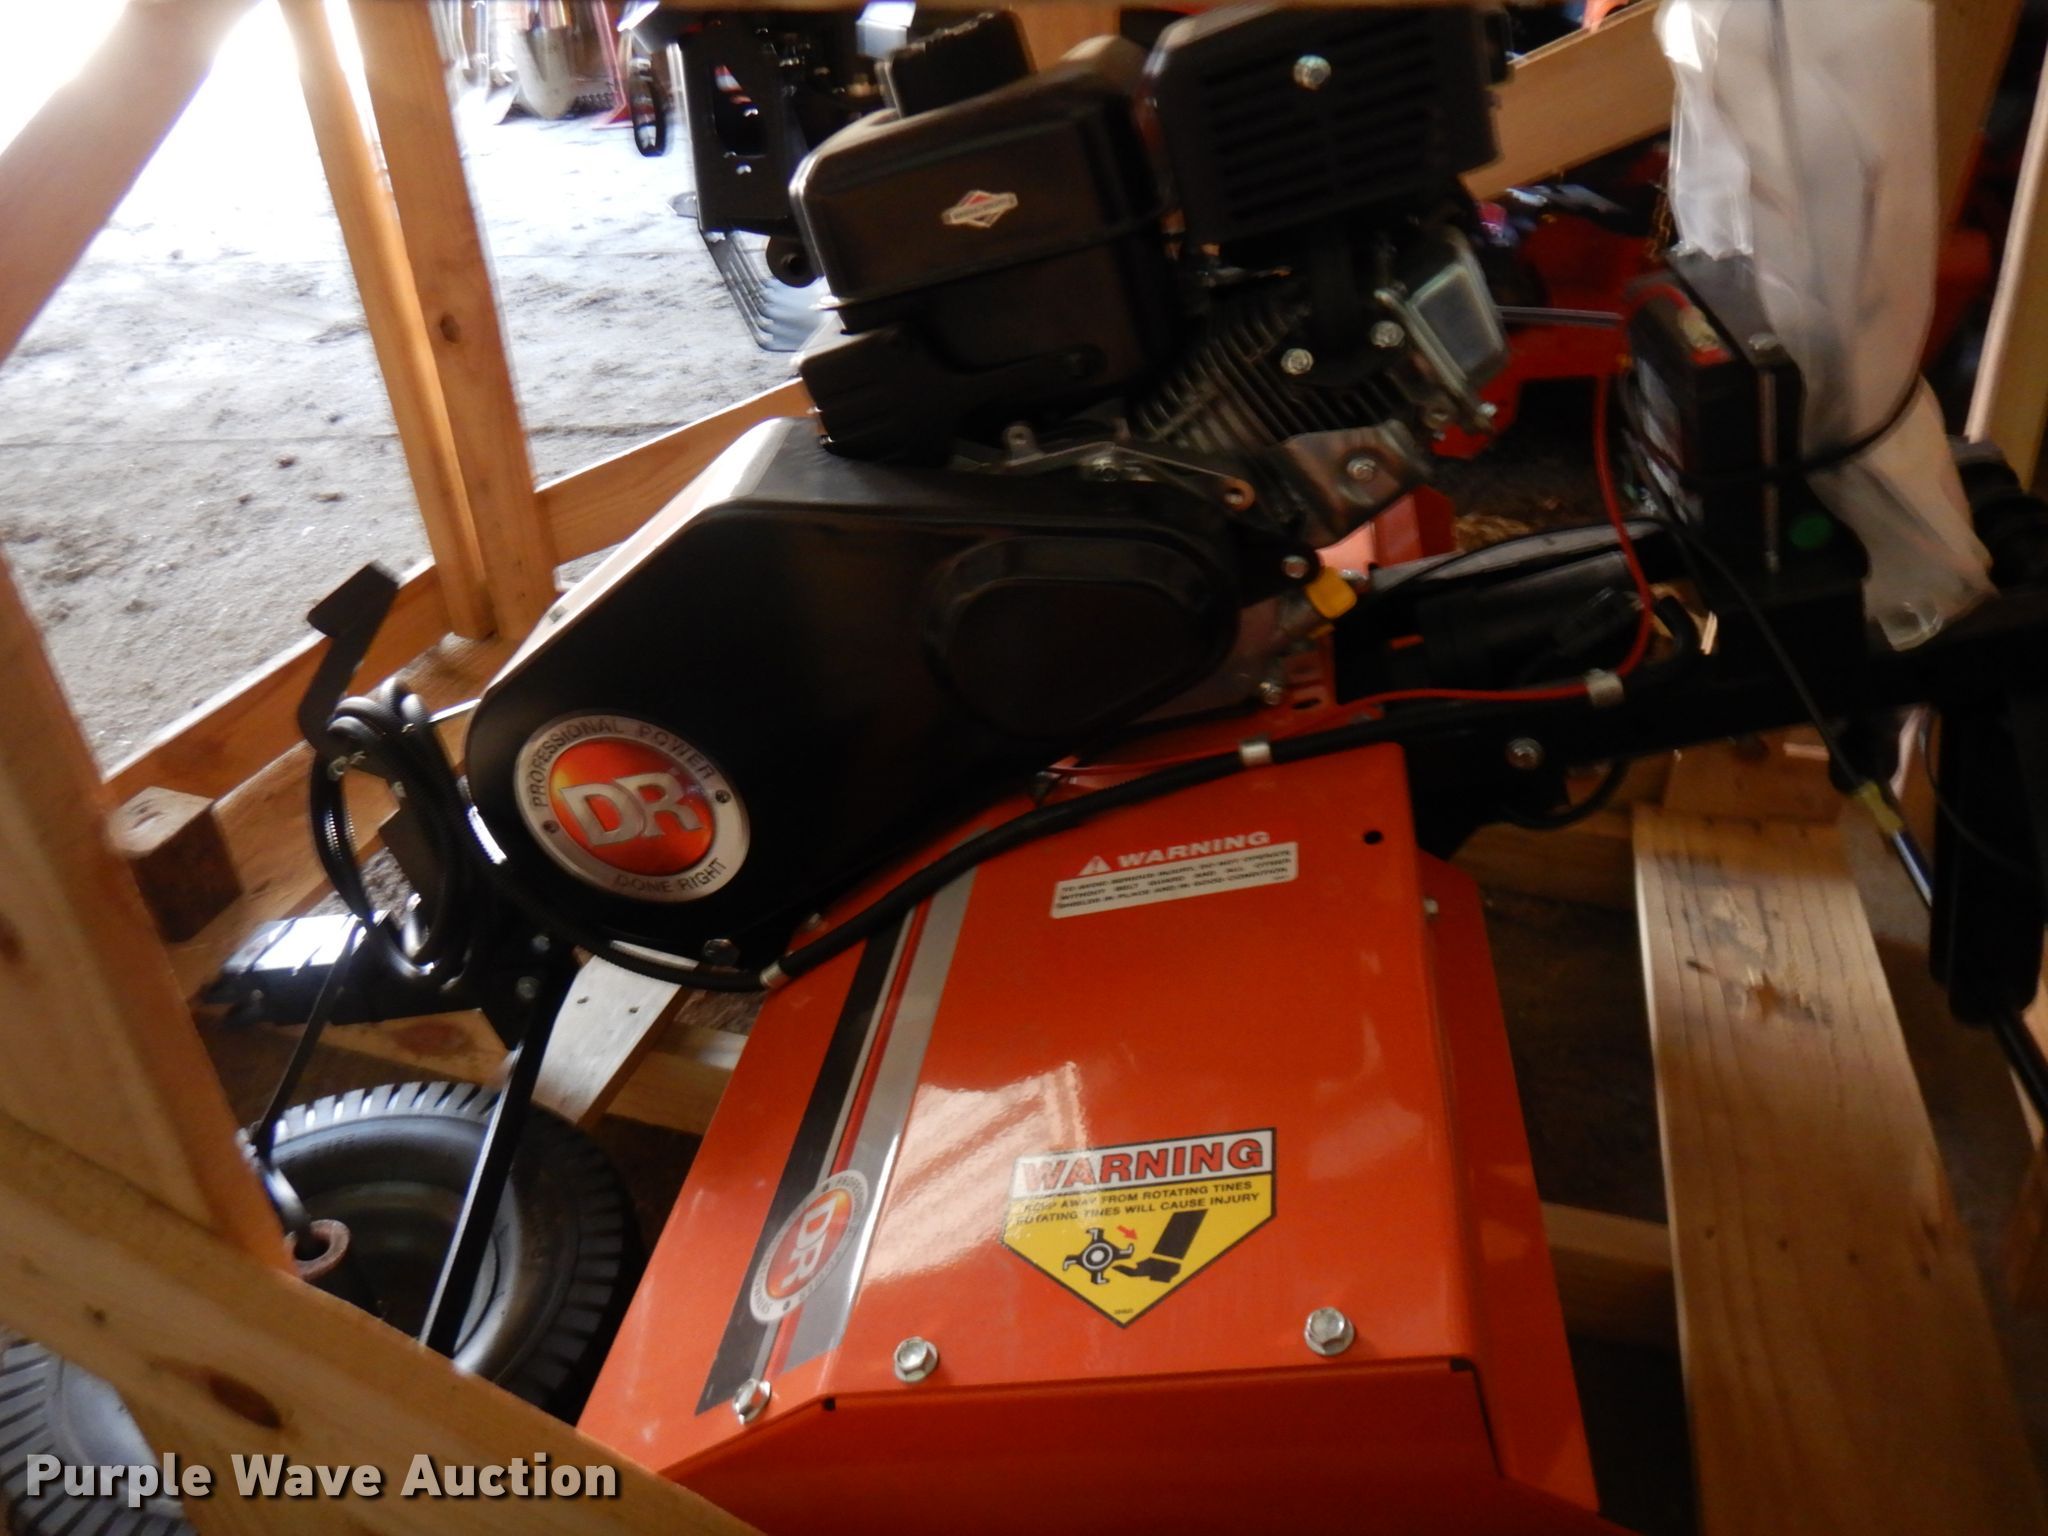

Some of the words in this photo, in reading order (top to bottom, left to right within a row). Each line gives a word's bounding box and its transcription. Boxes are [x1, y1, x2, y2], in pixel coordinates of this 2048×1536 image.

[528, 719, 625, 807] PROFESSIONAL
[637, 725, 716, 780] POWER
[559, 772, 704, 846] DR
[1117, 831, 1270, 867] WARNING
[615, 874, 674, 893] DONE
[677, 858, 727, 890] RIGHT
[1023, 1139, 1263, 1191] WARNING
[1061, 1197, 1097, 1208] AWAY
[1101, 1193, 1138, 1204] FROM
[1143, 1185, 1209, 1199] ROTATING
[1213, 1181, 1252, 1193] TINES
[1084, 1206, 1121, 1217] TINES
[1125, 1203, 1155, 1214] WILL
[1160, 1198, 1206, 1210] CAUSE
[1210, 1193, 1260, 1205] INJURY
[781, 1197, 838, 1289] DR
